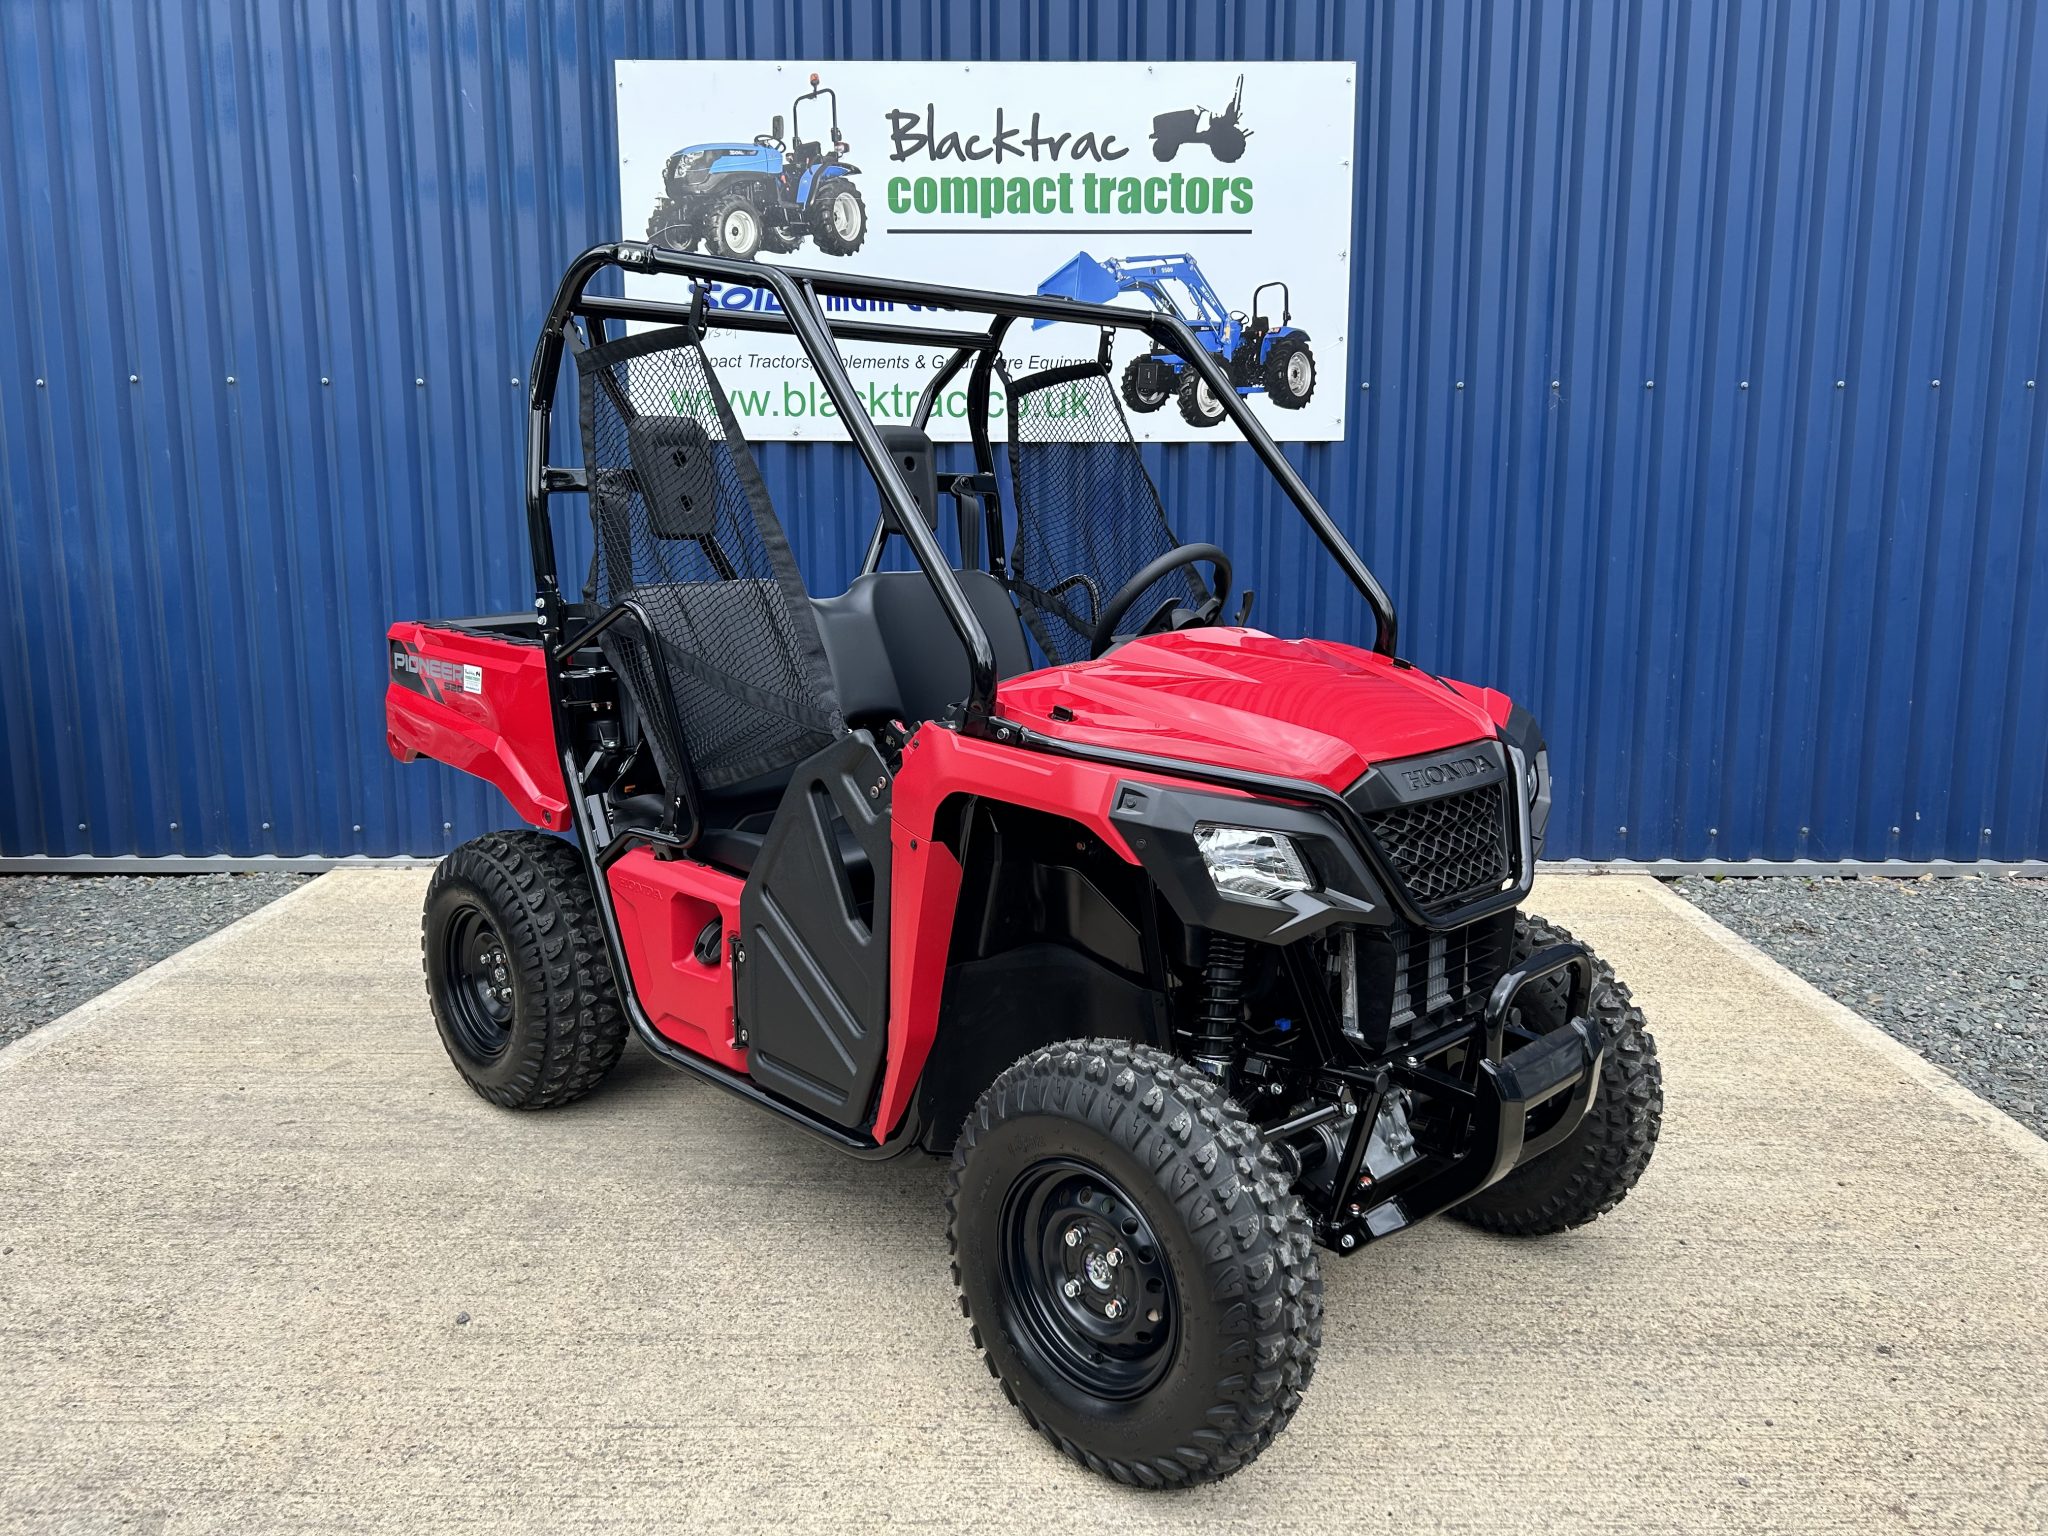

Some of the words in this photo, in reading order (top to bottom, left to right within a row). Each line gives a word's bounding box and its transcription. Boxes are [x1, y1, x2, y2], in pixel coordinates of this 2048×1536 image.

[885, 103, 1129, 164] Blacktrac
[887, 173, 1073, 218] compact
[1083, 173, 1254, 214] tractors
[672, 354, 742, 369] Copact
[747, 354, 813, 370] Tractors,
[840, 355, 910, 369] plements
[915, 355, 926, 369] &
[1028, 355, 1098, 370] Equipm
[394, 652, 464, 684] PIONEER
[1402, 754, 1497, 791] HONDA
